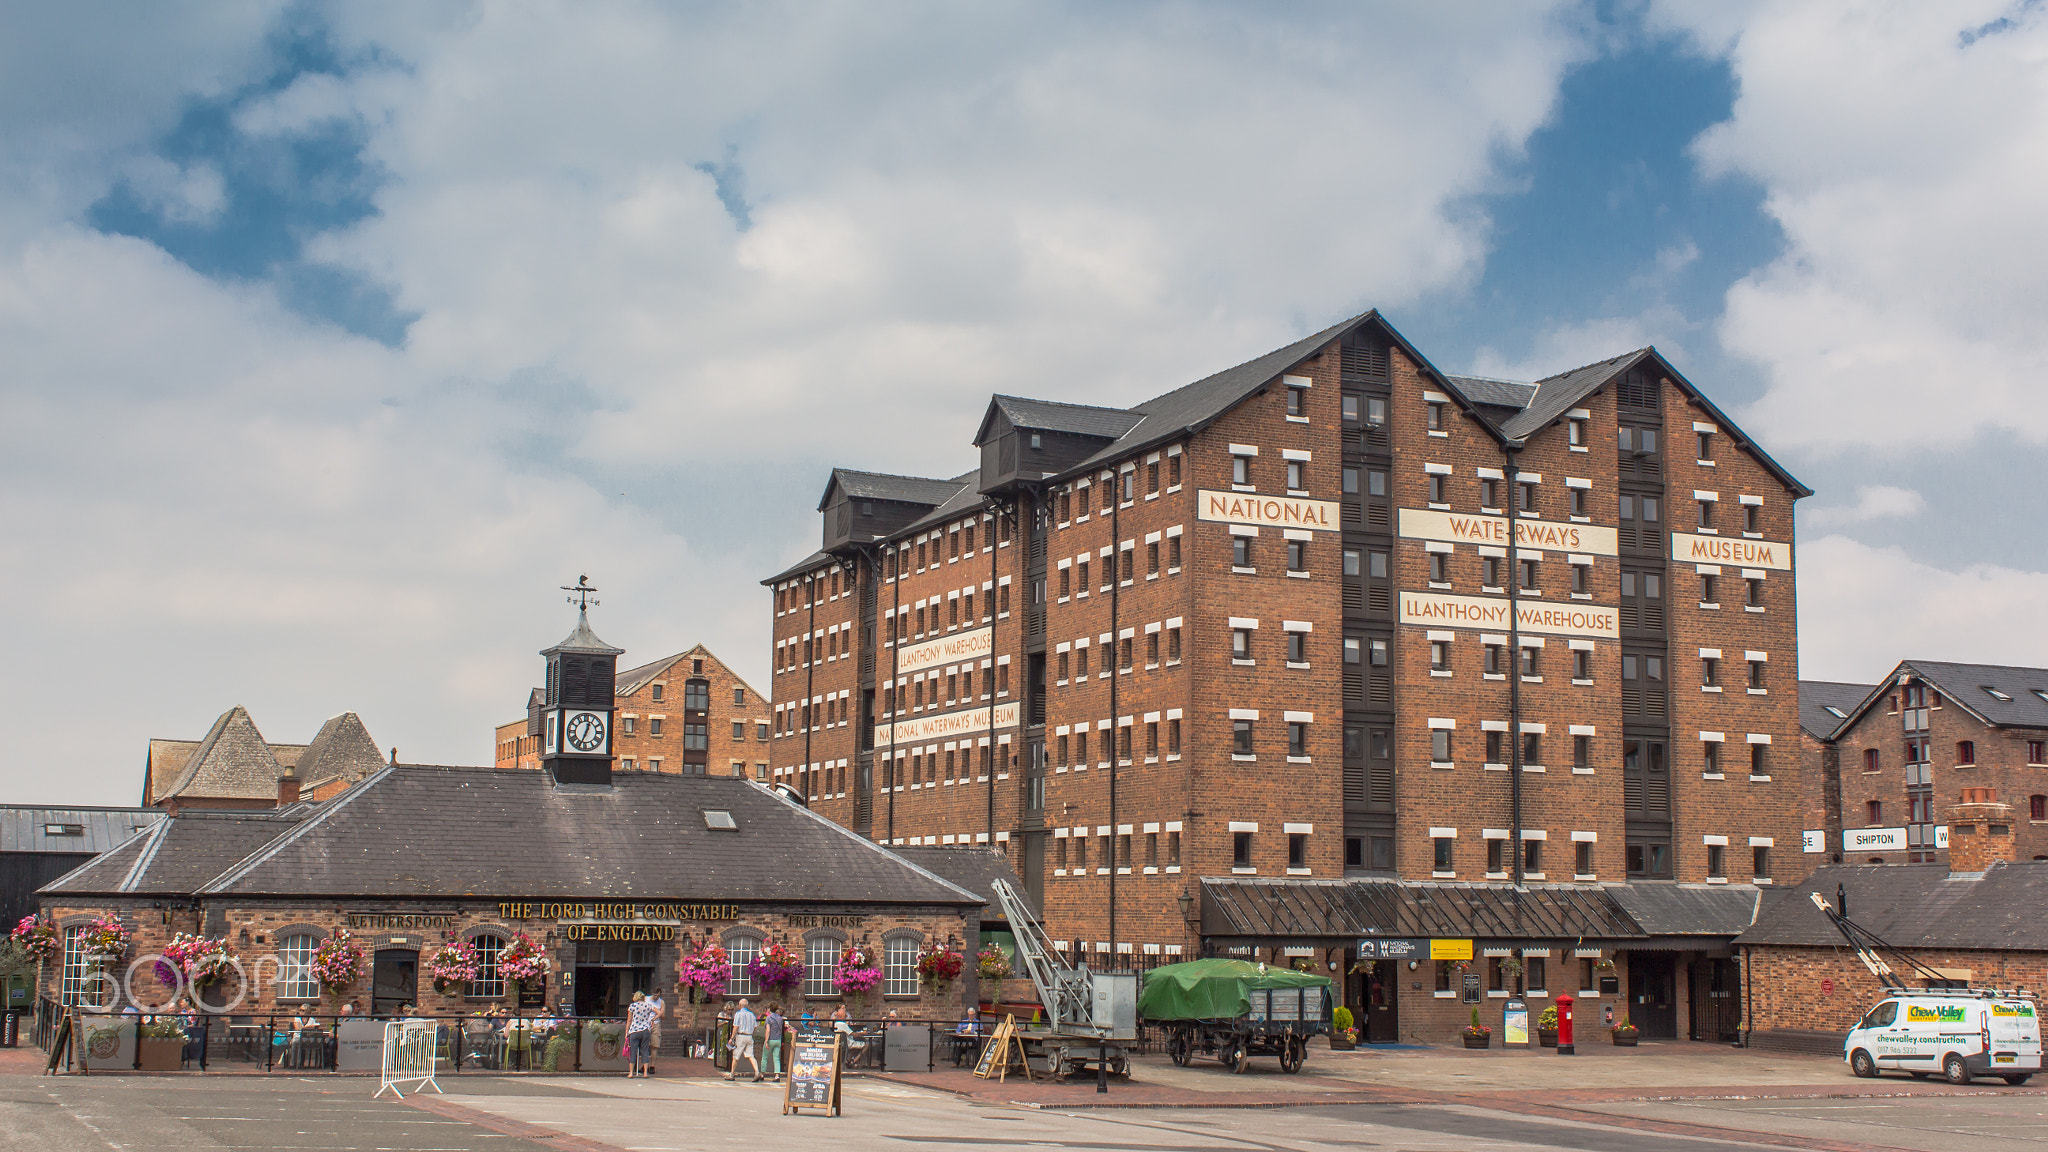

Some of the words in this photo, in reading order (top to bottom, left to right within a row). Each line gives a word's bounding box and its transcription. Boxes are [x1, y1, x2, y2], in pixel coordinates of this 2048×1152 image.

[1210, 495, 1329, 527] NATIONAL
[1449, 517, 1581, 548] WATERWAYS
[1691, 538, 1774, 565] MUSEUM
[1406, 600, 1507, 622] LLANTHONY
[1516, 607, 1613, 631] WAREHOUSE
[900, 644, 941, 668] LLANTHONY
[943, 633, 991, 657] WAREHOUSE
[879, 722, 919, 742] NAIONAL
[923, 714, 970, 735] WATERWAYS
[1856, 834, 1894, 845] SHIPTON
[499, 902, 532, 919] THE
[541, 903, 586, 919] LORD
[594, 903, 636, 920] HIGH
[644, 904, 740, 920] CONSTABLE
[348, 914, 452, 928] WETHERSPOON
[789, 915, 818, 928] FREE
[822, 916, 863, 928] HOUSE
[567, 924, 589, 941] OF
[597, 925, 675, 941] ENGLAND
[1910, 1005, 1937, 1017] Chew
[1936, 1004, 1964, 1021] Valley
[1877, 1034, 1967, 1045] chewvalley.construction
